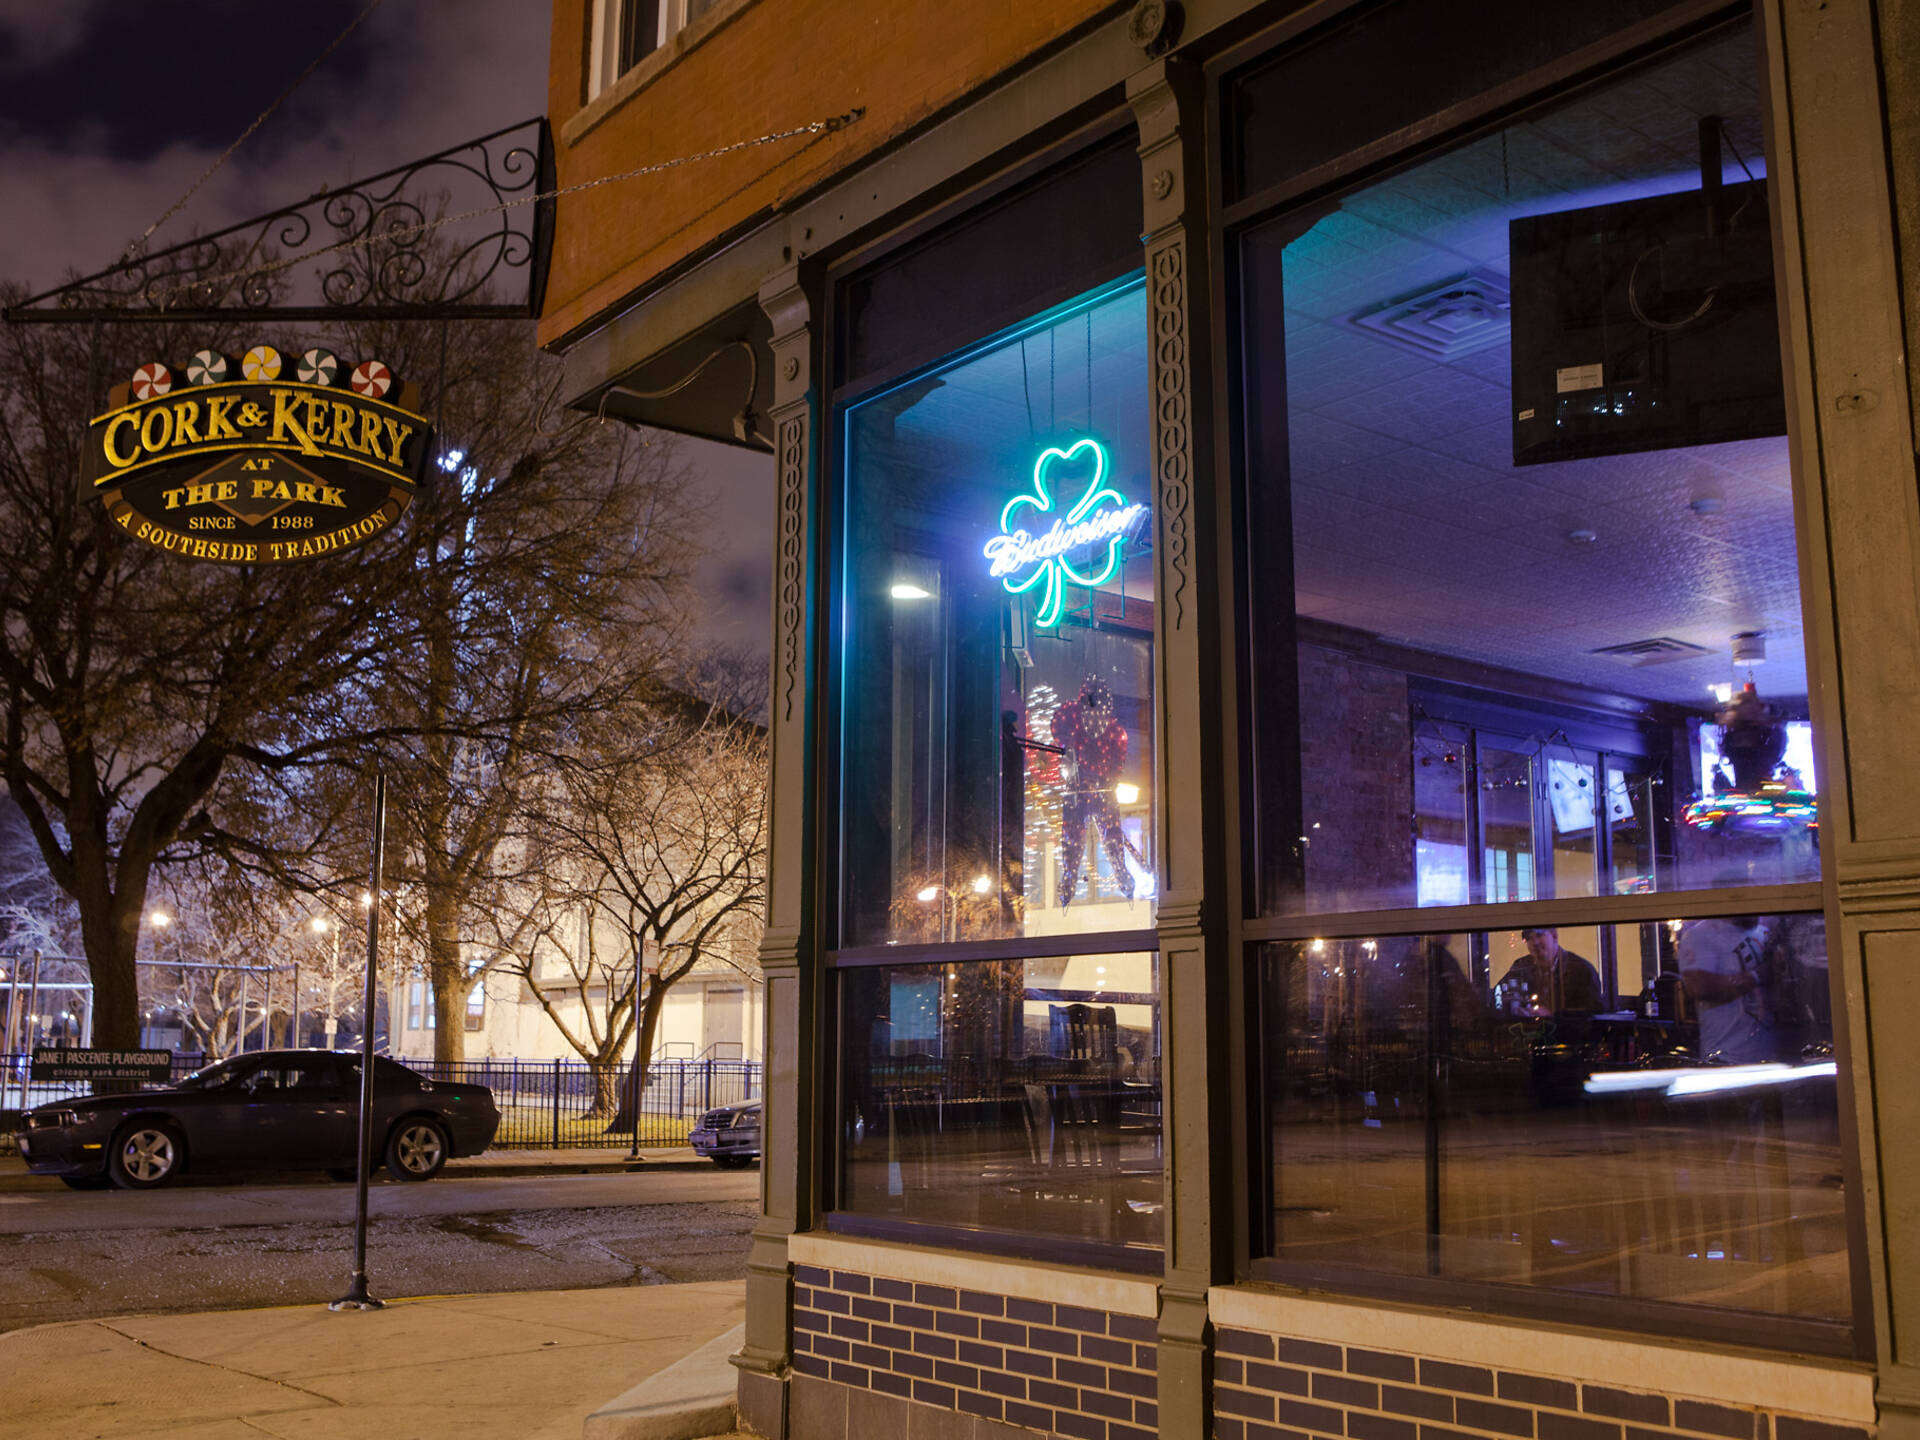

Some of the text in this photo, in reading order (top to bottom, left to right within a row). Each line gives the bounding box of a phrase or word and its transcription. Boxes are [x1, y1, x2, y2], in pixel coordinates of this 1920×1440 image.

[103, 388, 412, 468] CORK & KERRY
[241, 458, 274, 471] AT
[162, 479, 347, 510] THE PARK
[188, 515, 314, 530] SINCE 1988
[117, 508, 389, 562] A SOUTHSIDE TRADITION
[112, 1053, 169, 1065] PLAYGROUND
[53, 1068, 150, 1078] chicago park district
